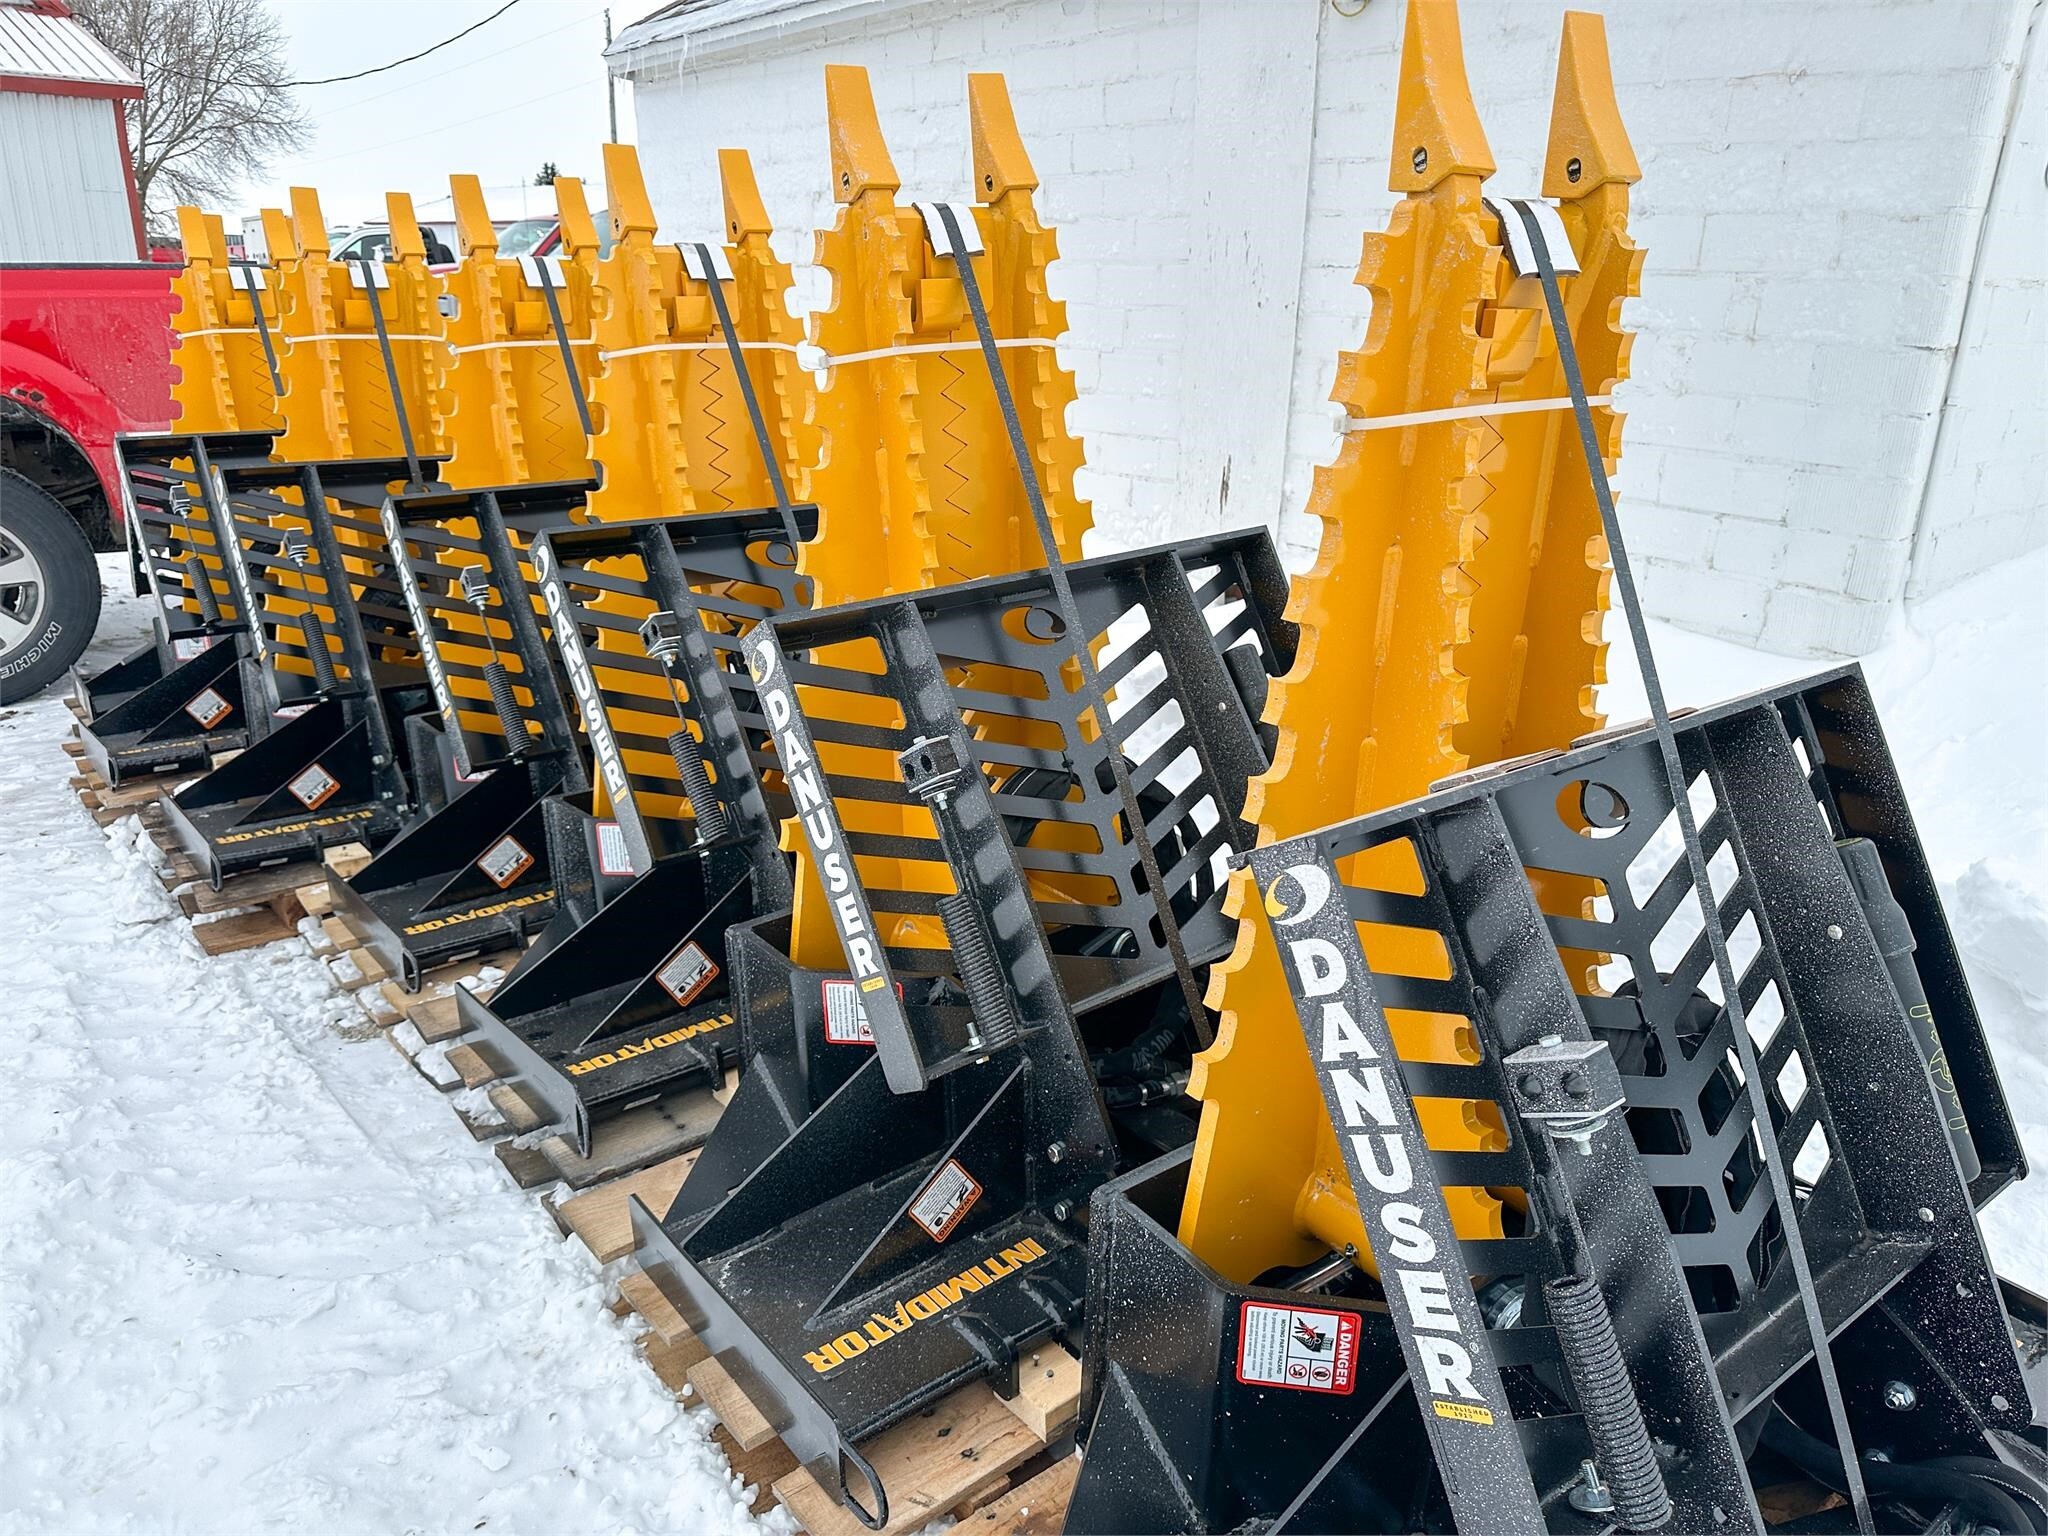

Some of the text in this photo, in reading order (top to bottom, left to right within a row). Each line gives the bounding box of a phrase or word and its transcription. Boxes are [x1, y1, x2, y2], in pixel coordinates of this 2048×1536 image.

[391, 538, 449, 712] DANUSER
[544, 581, 625, 793] DANUSER
[766, 688, 880, 978] DANUSER
[936, 1197, 972, 1237] WARNING
[1291, 937, 1487, 1402] DANUSER
[802, 1237, 1047, 1373] INTIMIDATOR
[1335, 1332, 1352, 1386] DANGER
[1434, 1403, 1489, 1416] ESTABLISHED
